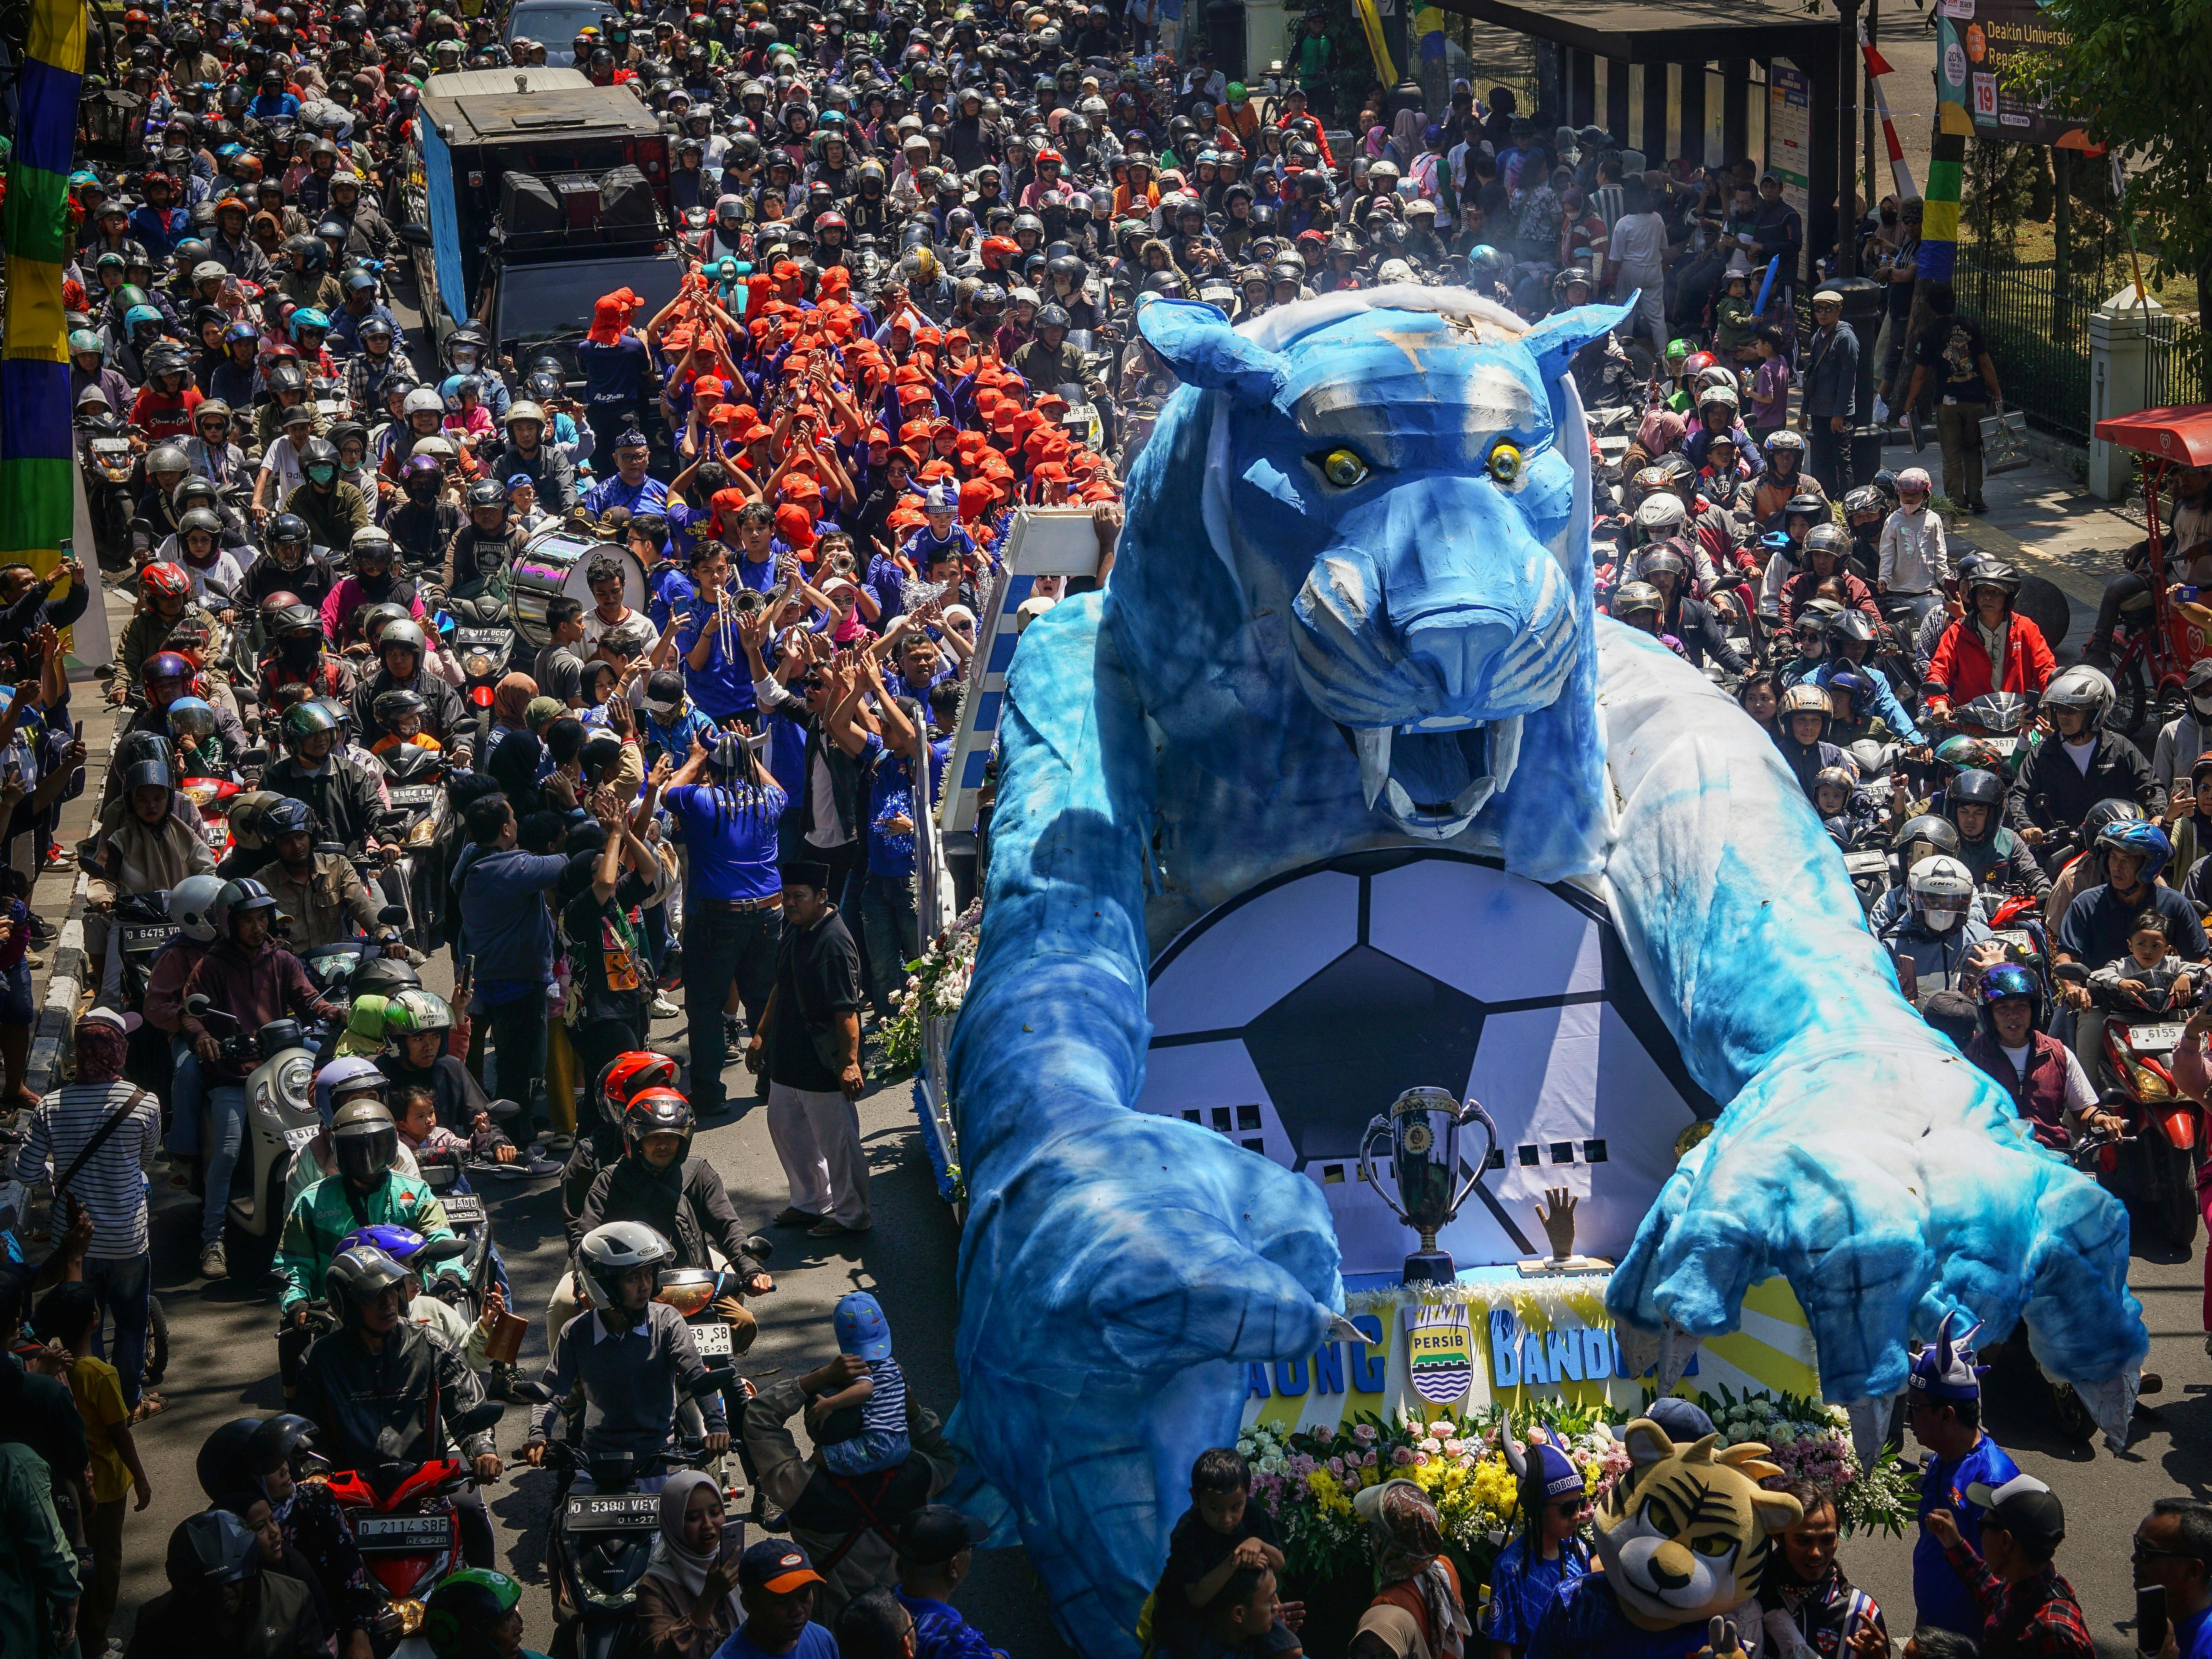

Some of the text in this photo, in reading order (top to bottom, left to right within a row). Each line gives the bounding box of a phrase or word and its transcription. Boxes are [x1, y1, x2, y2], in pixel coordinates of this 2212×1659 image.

[1988, 21, 2022, 41] Deakin
[1948, 51, 1962, 62] 20%
[1974, 76, 1994, 84] THURSDAY
[1977, 85, 1993, 112] 19
[151, 419, 171, 427] Silence
[177, 416, 190, 426] Gold
[1717, 482, 1729, 492] 46
[1868, 787, 1889, 796] 2578
[127, 931, 132, 939] D
[141, 928, 165, 939] 6475
[2132, 1028, 2176, 1038] D 6155
[348, 1067, 369, 1076] Classic
[285, 1131, 292, 1141] D
[316, 1208, 341, 1219] Grab
[713, 1326, 728, 1338] SB
[1414, 1333, 1464, 1349] PERSIB
[573, 1498, 657, 1514] D 5388 VEY
[361, 1517, 447, 1535] D 2114 SBF
[203, 1565, 229, 1577] HONDA
